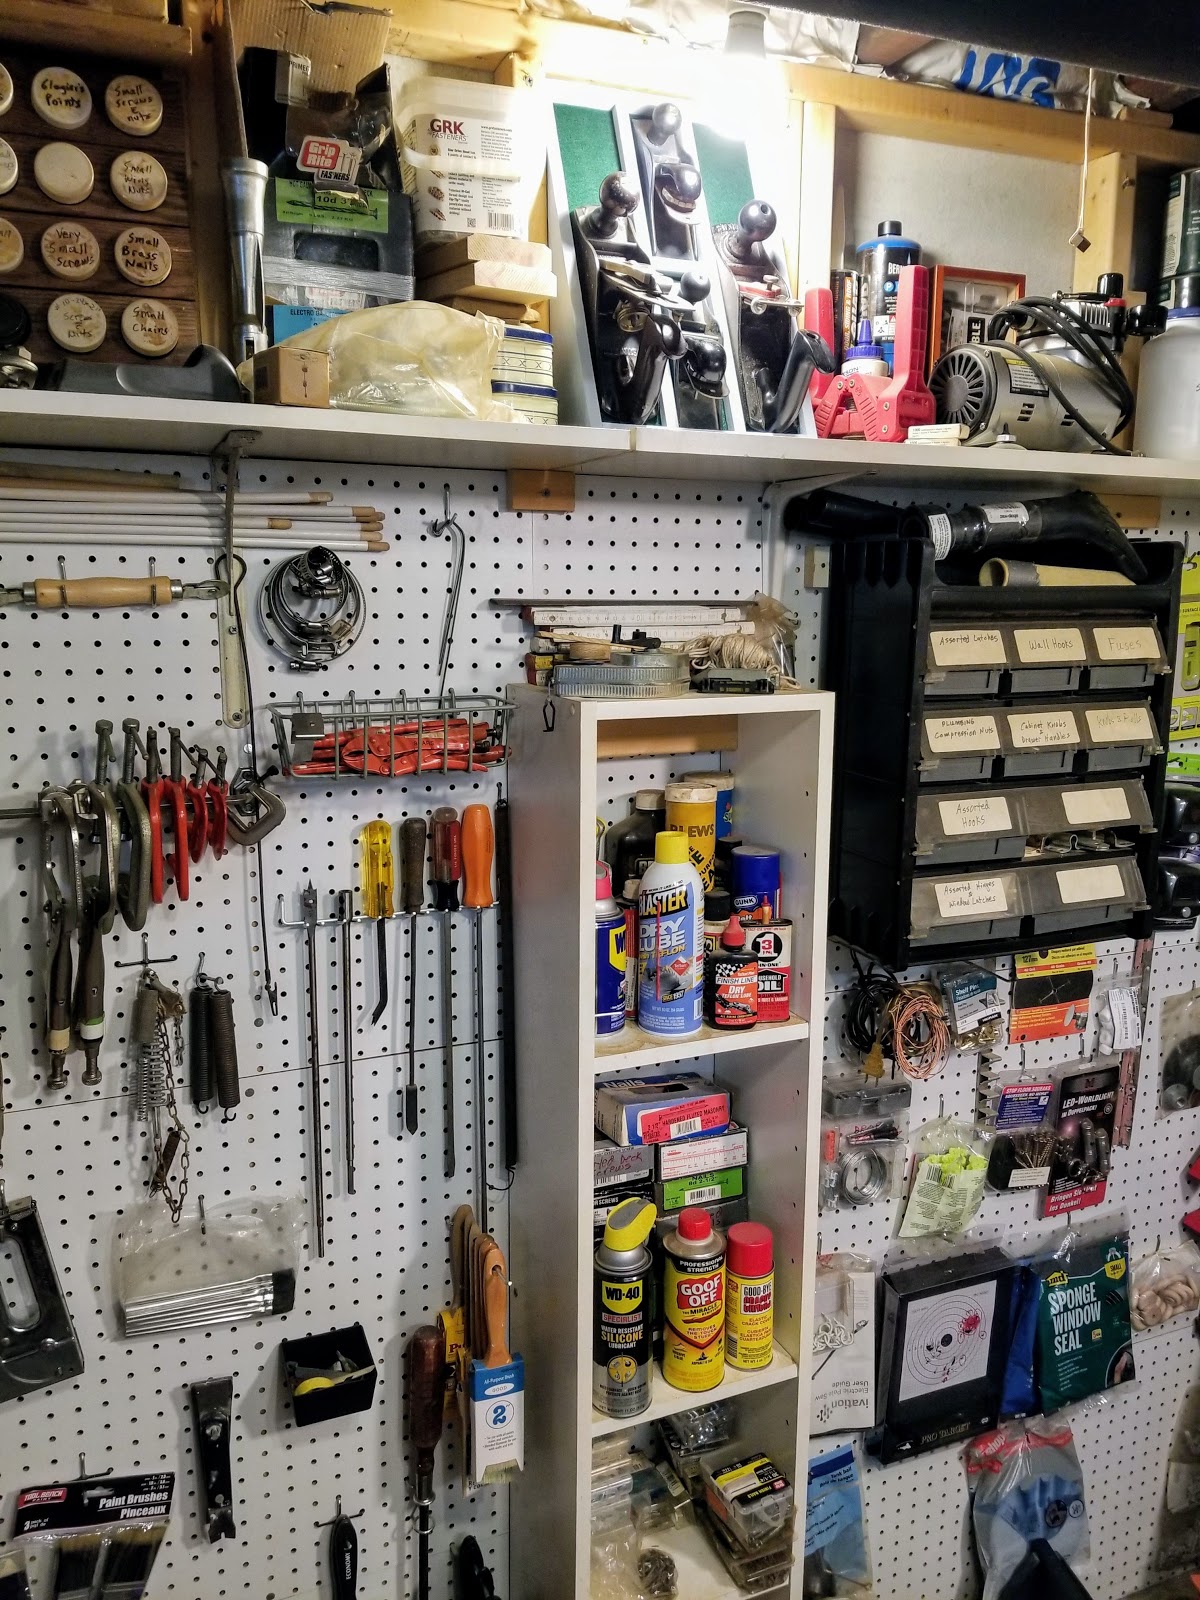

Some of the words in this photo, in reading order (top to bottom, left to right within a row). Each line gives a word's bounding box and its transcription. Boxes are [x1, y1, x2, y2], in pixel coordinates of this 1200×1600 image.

[115, 85, 144, 97] Small
[46, 95, 82, 108] Points
[127, 113, 152, 122] nuts
[430, 119, 465, 135] GRK
[431, 132, 467, 141] FASTENERS
[308, 142, 336, 156] Grip
[306, 153, 333, 167] Rite
[124, 161, 152, 174] Small
[128, 185, 150, 195] Nuts
[56, 229, 81, 242] Very
[127, 233, 159, 248] Small
[50, 243, 88, 254] Small
[122, 246, 158, 261] Brass
[57, 255, 95, 267] Screws
[126, 259, 159, 272] Nails
[845, 279, 853, 298] ROOF
[133, 307, 165, 320] Small
[844, 305, 852, 329] SIDING
[133, 324, 168, 335] Chains
[939, 634, 970, 646] Assorted
[1029, 640, 1050, 650] Wall
[1052, 638, 1073, 649] Hooks
[1108, 637, 1142, 651] Fuses
[941, 719, 975, 728] PLUMBING
[1020, 721, 1043, 731] Cabinet
[1047, 720, 1067, 730] Knobs
[934, 728, 977, 740] Compression
[979, 726, 995, 735] Nuts
[1021, 735, 1042, 744] Drawer
[1044, 731, 1071, 742] Handles
[956, 800, 990, 815] Assorted
[944, 883, 971, 896] Assorted
[976, 880, 995, 892] Hinges
[972, 895, 996, 905] Latches
[640, 915, 686, 938] DRY
[639, 929, 686, 952] LUBE
[762, 940, 773, 950] 3
[716, 977, 740, 985] FINISH
[741, 976, 755, 984] LINE
[728, 985, 745, 994] DRY
[603, 1080, 645, 1089] Nails
[704, 1105, 725, 1115] MASONRY
[621, 1152, 642, 1164] Deck
[599, 1197, 619, 1205] SCREWS
[680, 1256, 723, 1268] PROFESSIONAL
[687, 1263, 719, 1273] STRENGTH
[1110, 1263, 1122, 1271] SMALL
[1050, 1273, 1065, 1284] md
[681, 1275, 721, 1296] GOOF
[605, 1286, 641, 1301] WD-40
[689, 1289, 717, 1307] OFF
[1048, 1281, 1097, 1315] SPONGE
[690, 1303, 717, 1315] MIRACLE
[604, 1314, 640, 1323] SPECIALIST
[1052, 1301, 1101, 1335] WINDOW
[618, 1324, 643, 1333] RESISTANT
[688, 1324, 716, 1332] REMOVES
[601, 1330, 644, 1343] SILICONE
[1054, 1329, 1082, 1356] SEAL
[608, 1341, 636, 1349] LUBRICANT
[814, 1393, 827, 1401] Saw
[831, 1399, 868, 1409] ivation
[921, 1433, 938, 1444] PRO
[939, 1422, 970, 1438] TARGET
[24, 1492, 40, 1501] TOOL
[41, 1490, 63, 1499] BENCH
[99, 1496, 126, 1509] Paint
[127, 1491, 168, 1505] Brushes
[120, 1505, 166, 1519] Pinceaux
[24, 1520, 30, 1531] 3
